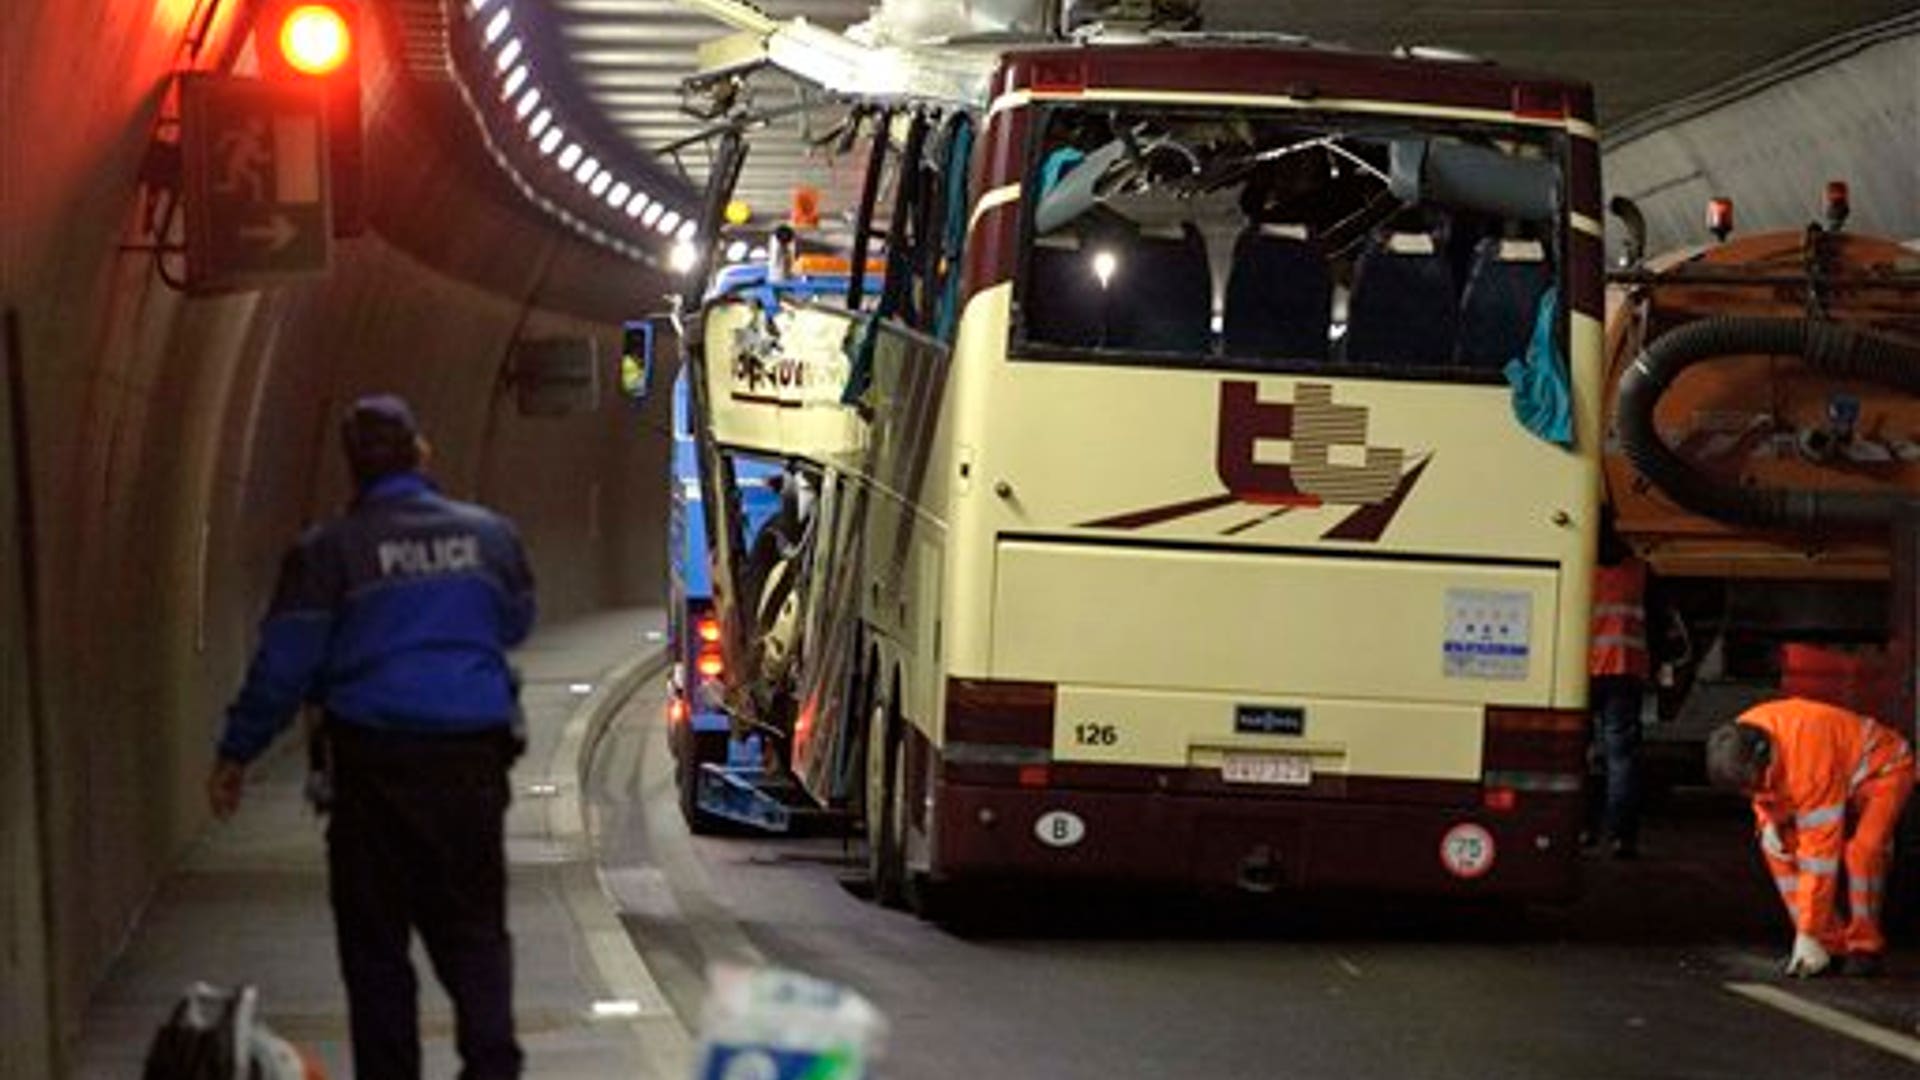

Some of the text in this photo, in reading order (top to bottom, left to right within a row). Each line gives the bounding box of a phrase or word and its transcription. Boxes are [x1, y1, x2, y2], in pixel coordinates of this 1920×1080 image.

[1074, 723, 1118, 746] 126
[1052, 817, 1070, 840] B
[1449, 836, 1482, 859] 75
